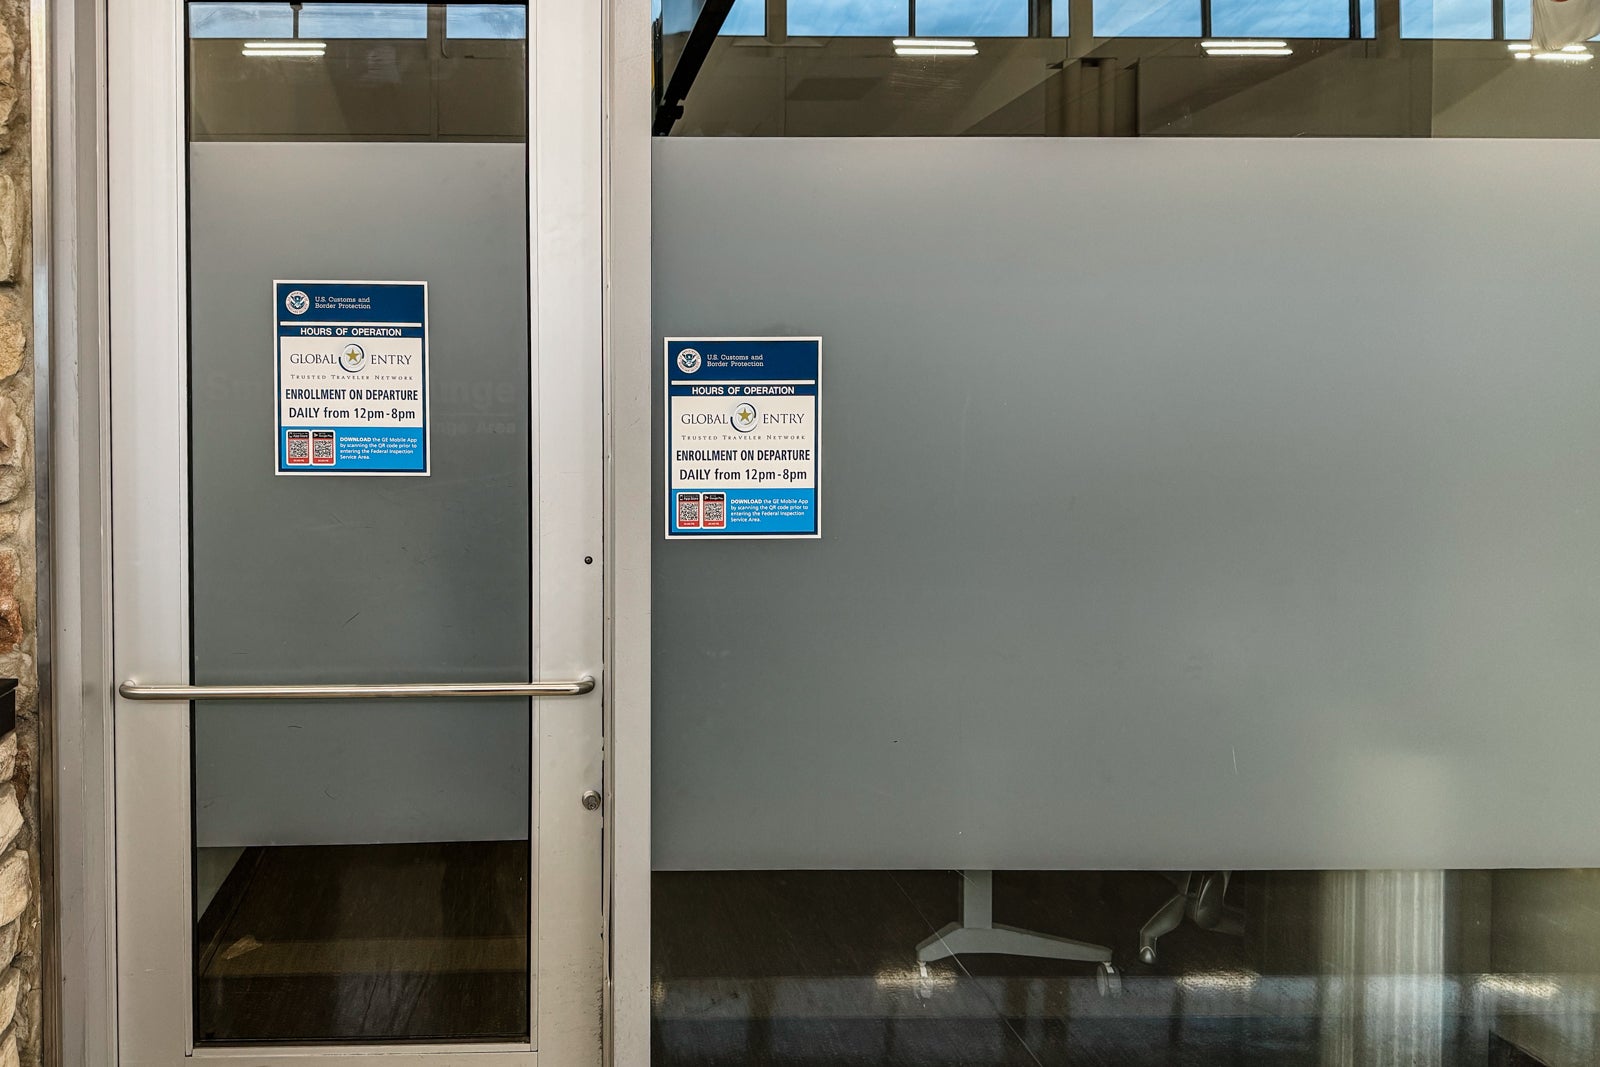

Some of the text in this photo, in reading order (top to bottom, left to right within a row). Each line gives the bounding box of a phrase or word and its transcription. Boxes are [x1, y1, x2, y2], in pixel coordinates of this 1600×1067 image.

[300, 327, 402, 336] HOURS OF OPERATION
[290, 354, 412, 365] GLOBAL ENTRY
[285, 388, 418, 401] ENROLLMENT ON DEPARTURE
[692, 386, 794, 395] HOURS OF OPERATION
[289, 407, 320, 418] DAILY
[324, 407, 349, 419] from
[681, 414, 804, 425] GLOBAL ENTRY
[676, 450, 810, 461] ENROLLMENT ON DEPARTURE
[680, 469, 711, 480] DAILY
[714, 468, 741, 480] from
